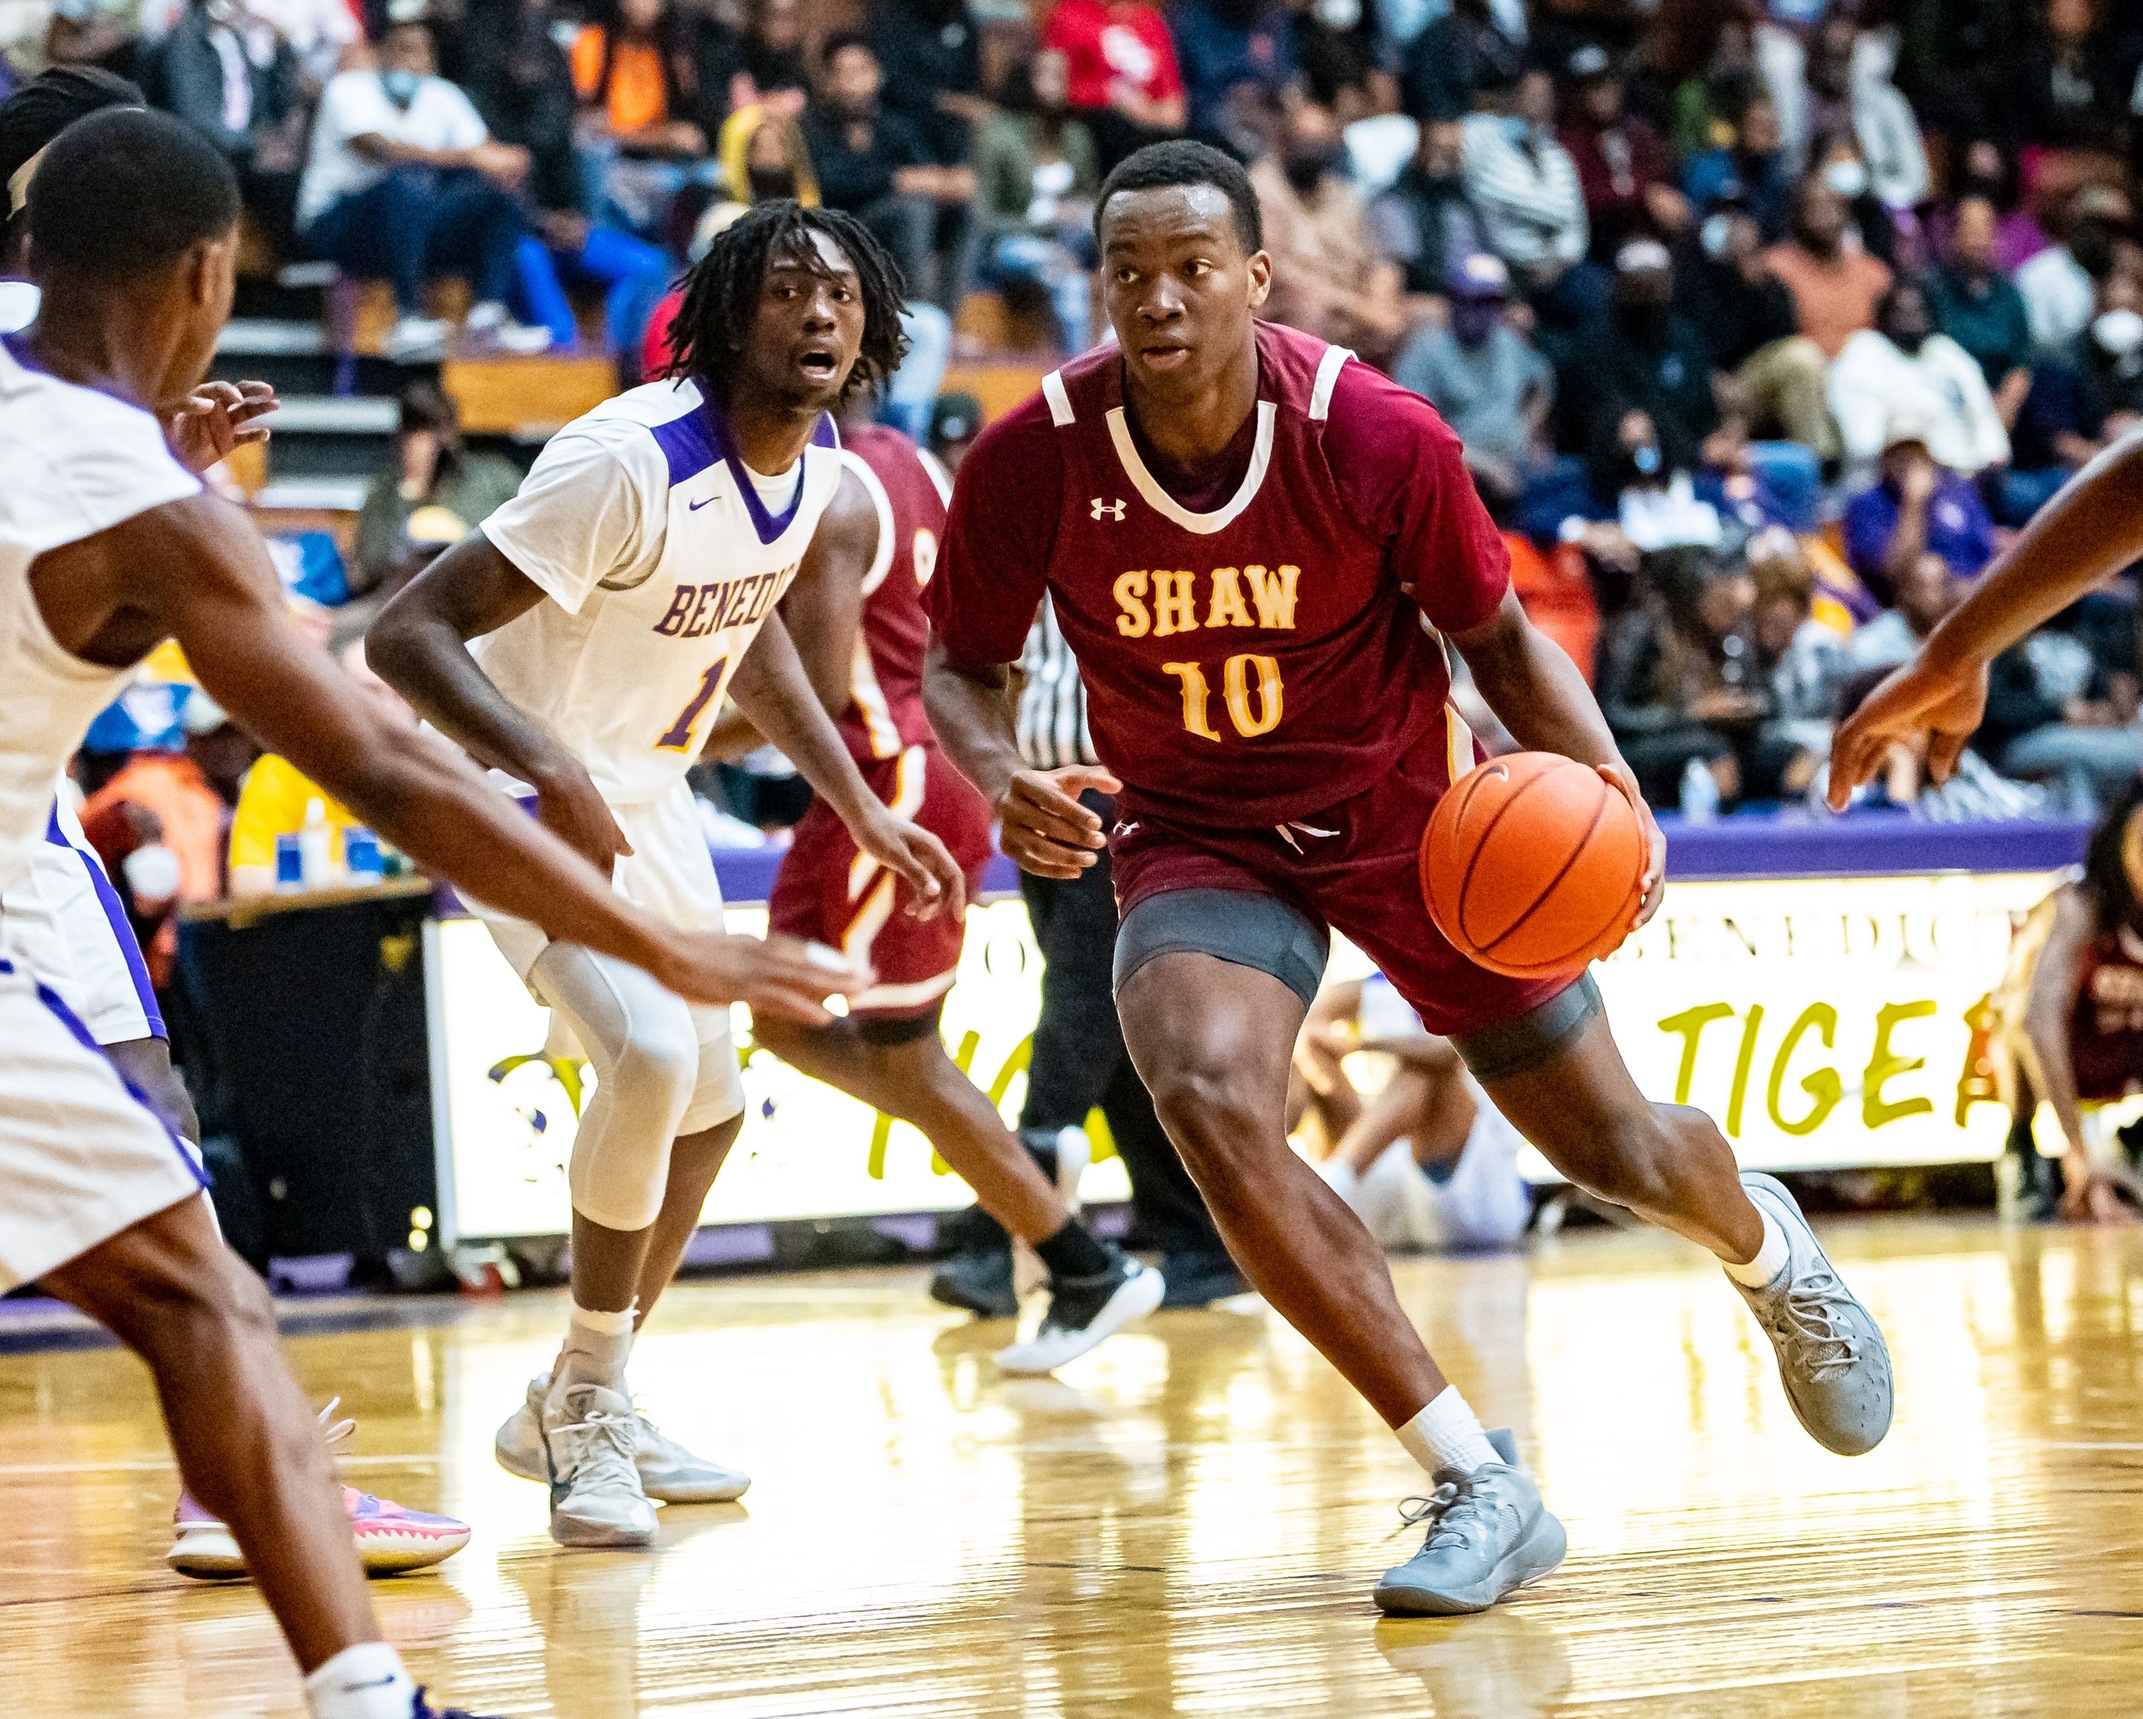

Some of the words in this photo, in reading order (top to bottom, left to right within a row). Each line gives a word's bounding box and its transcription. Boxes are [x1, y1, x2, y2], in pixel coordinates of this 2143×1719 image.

[1113, 565, 1301, 638] SHAW
[655, 655, 728, 754] 1
[1162, 654, 1284, 742] 10
